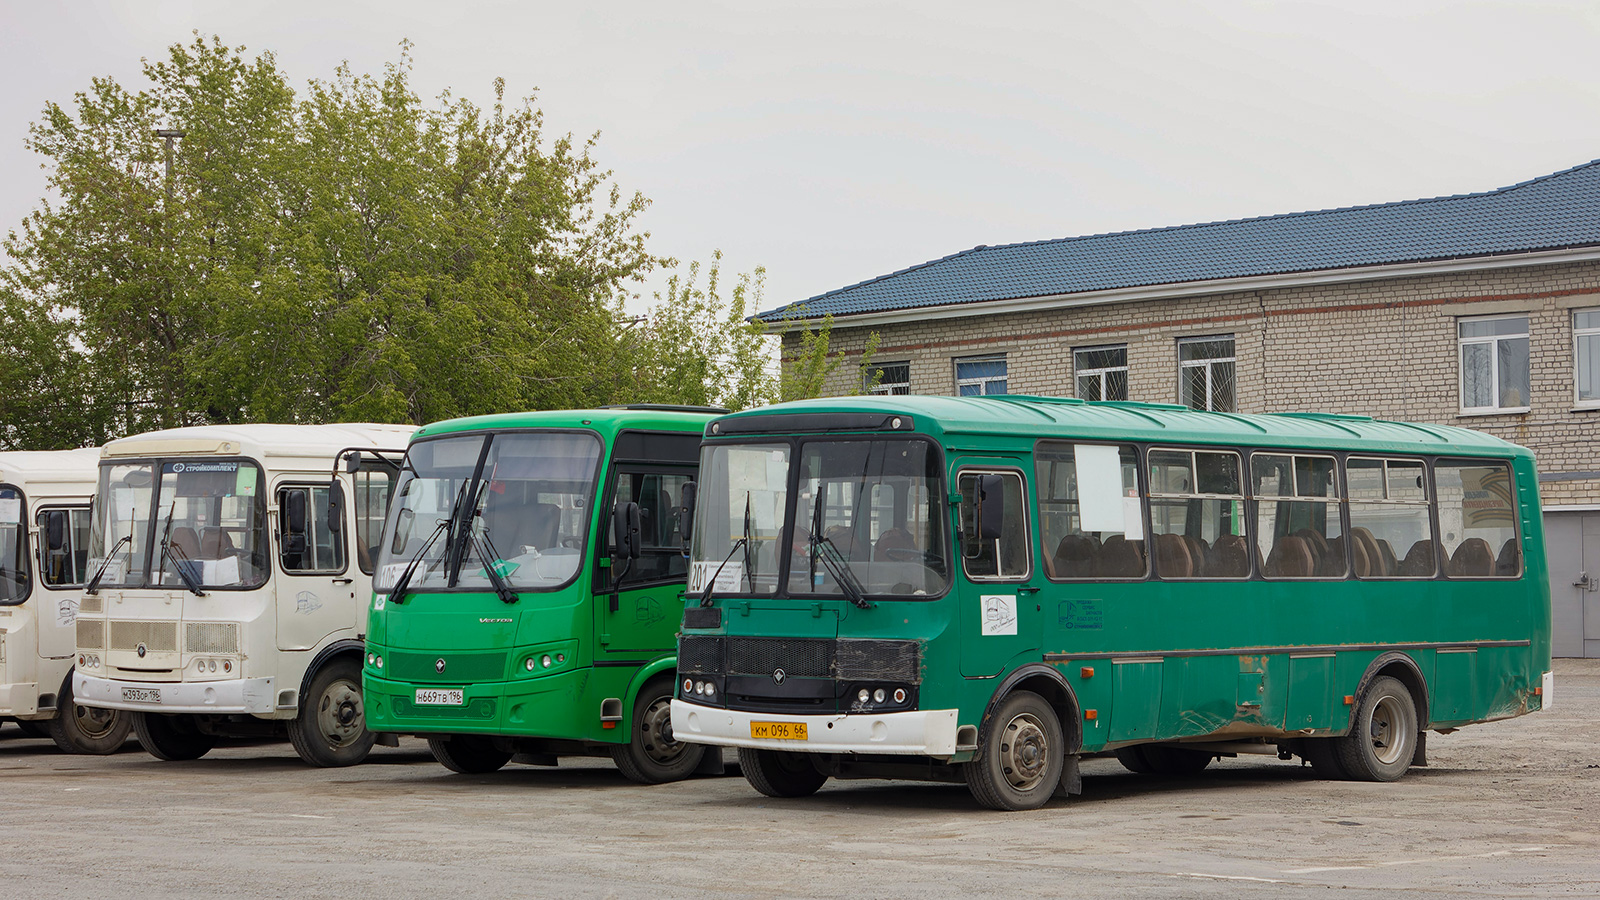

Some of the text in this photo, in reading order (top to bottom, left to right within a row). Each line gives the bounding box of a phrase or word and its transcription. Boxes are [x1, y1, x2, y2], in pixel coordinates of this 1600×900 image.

[382, 566, 396, 588] 106
[692, 564, 708, 591] 201
[123, 690, 148, 700] М393ОР
[417, 691, 462, 703] Н669ТВ 196
[755, 724, 804, 737] КМ 096 66
